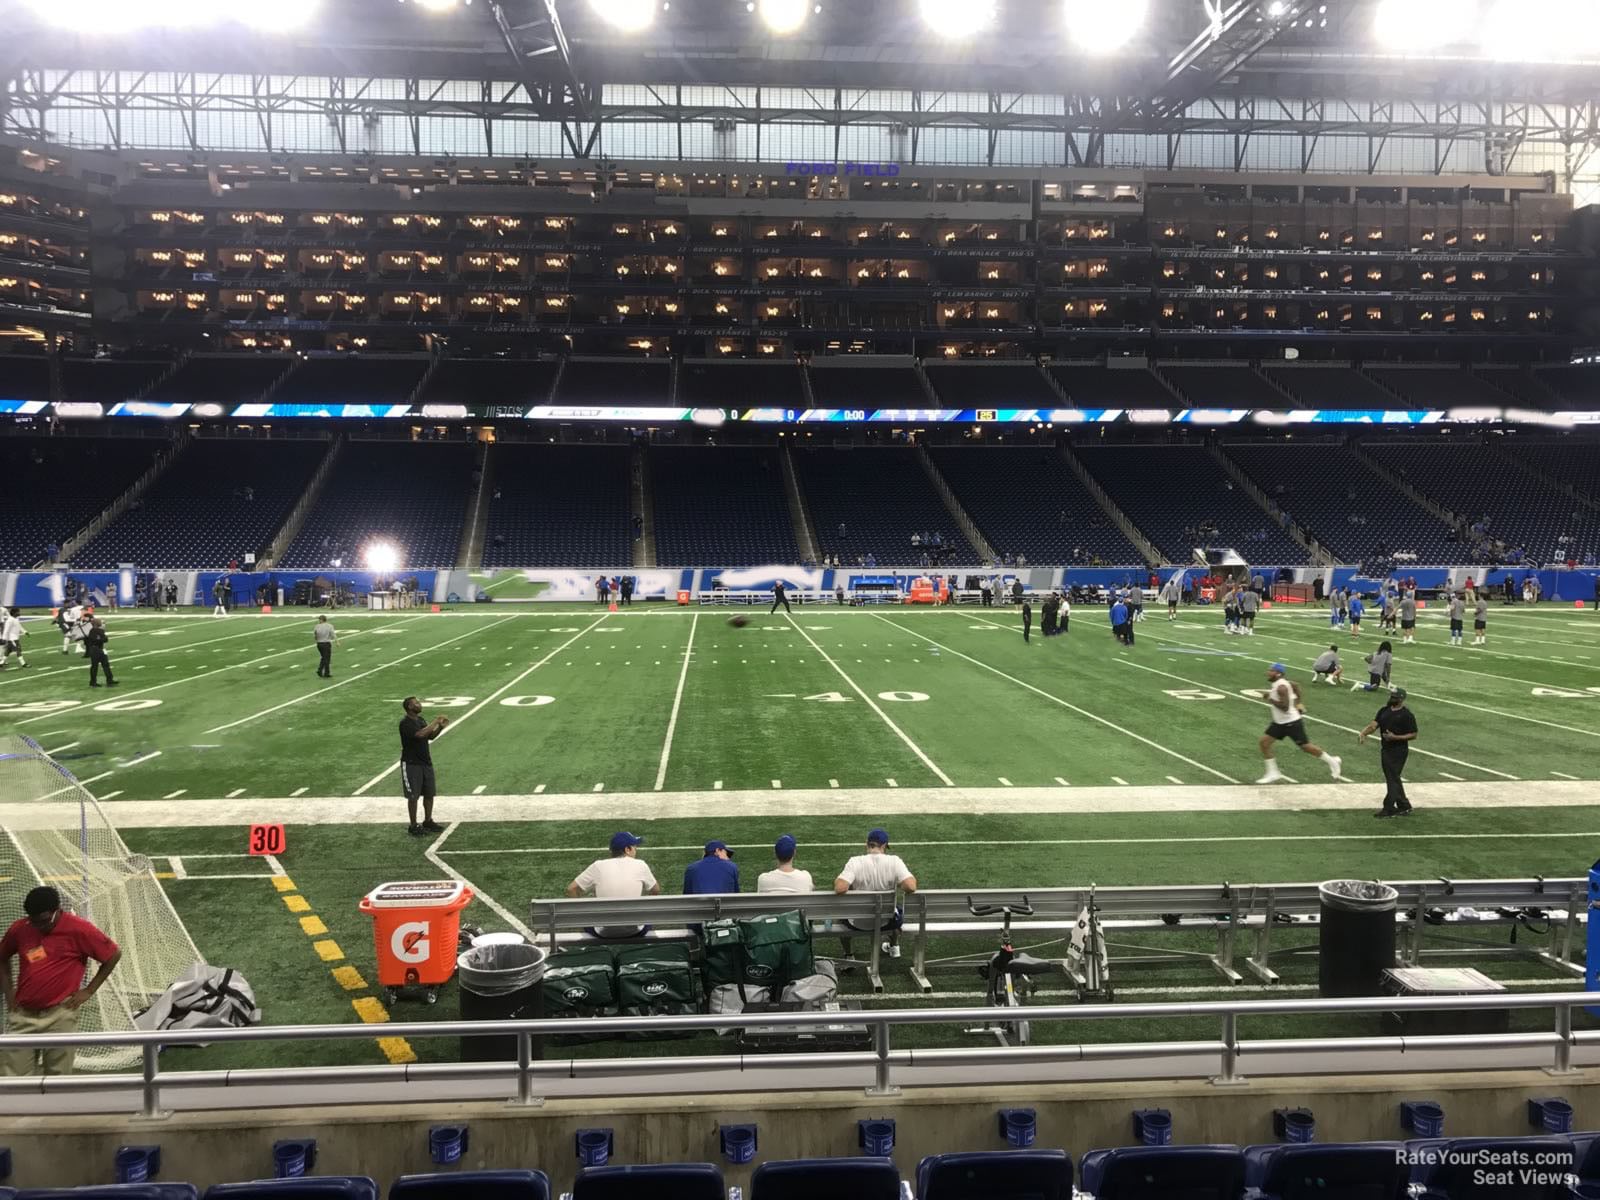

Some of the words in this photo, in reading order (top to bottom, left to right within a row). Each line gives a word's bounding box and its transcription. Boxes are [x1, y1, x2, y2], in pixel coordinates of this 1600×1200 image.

[785, 163, 838, 175] FORD
[845, 163, 900, 176] FIELD
[731, 410, 738, 420] 0
[788, 410, 795, 419] 0
[844, 410, 865, 420] 0:00
[979, 411, 993, 420] 25
[253, 825, 280, 851] 30
[391, 921, 430, 963] G
